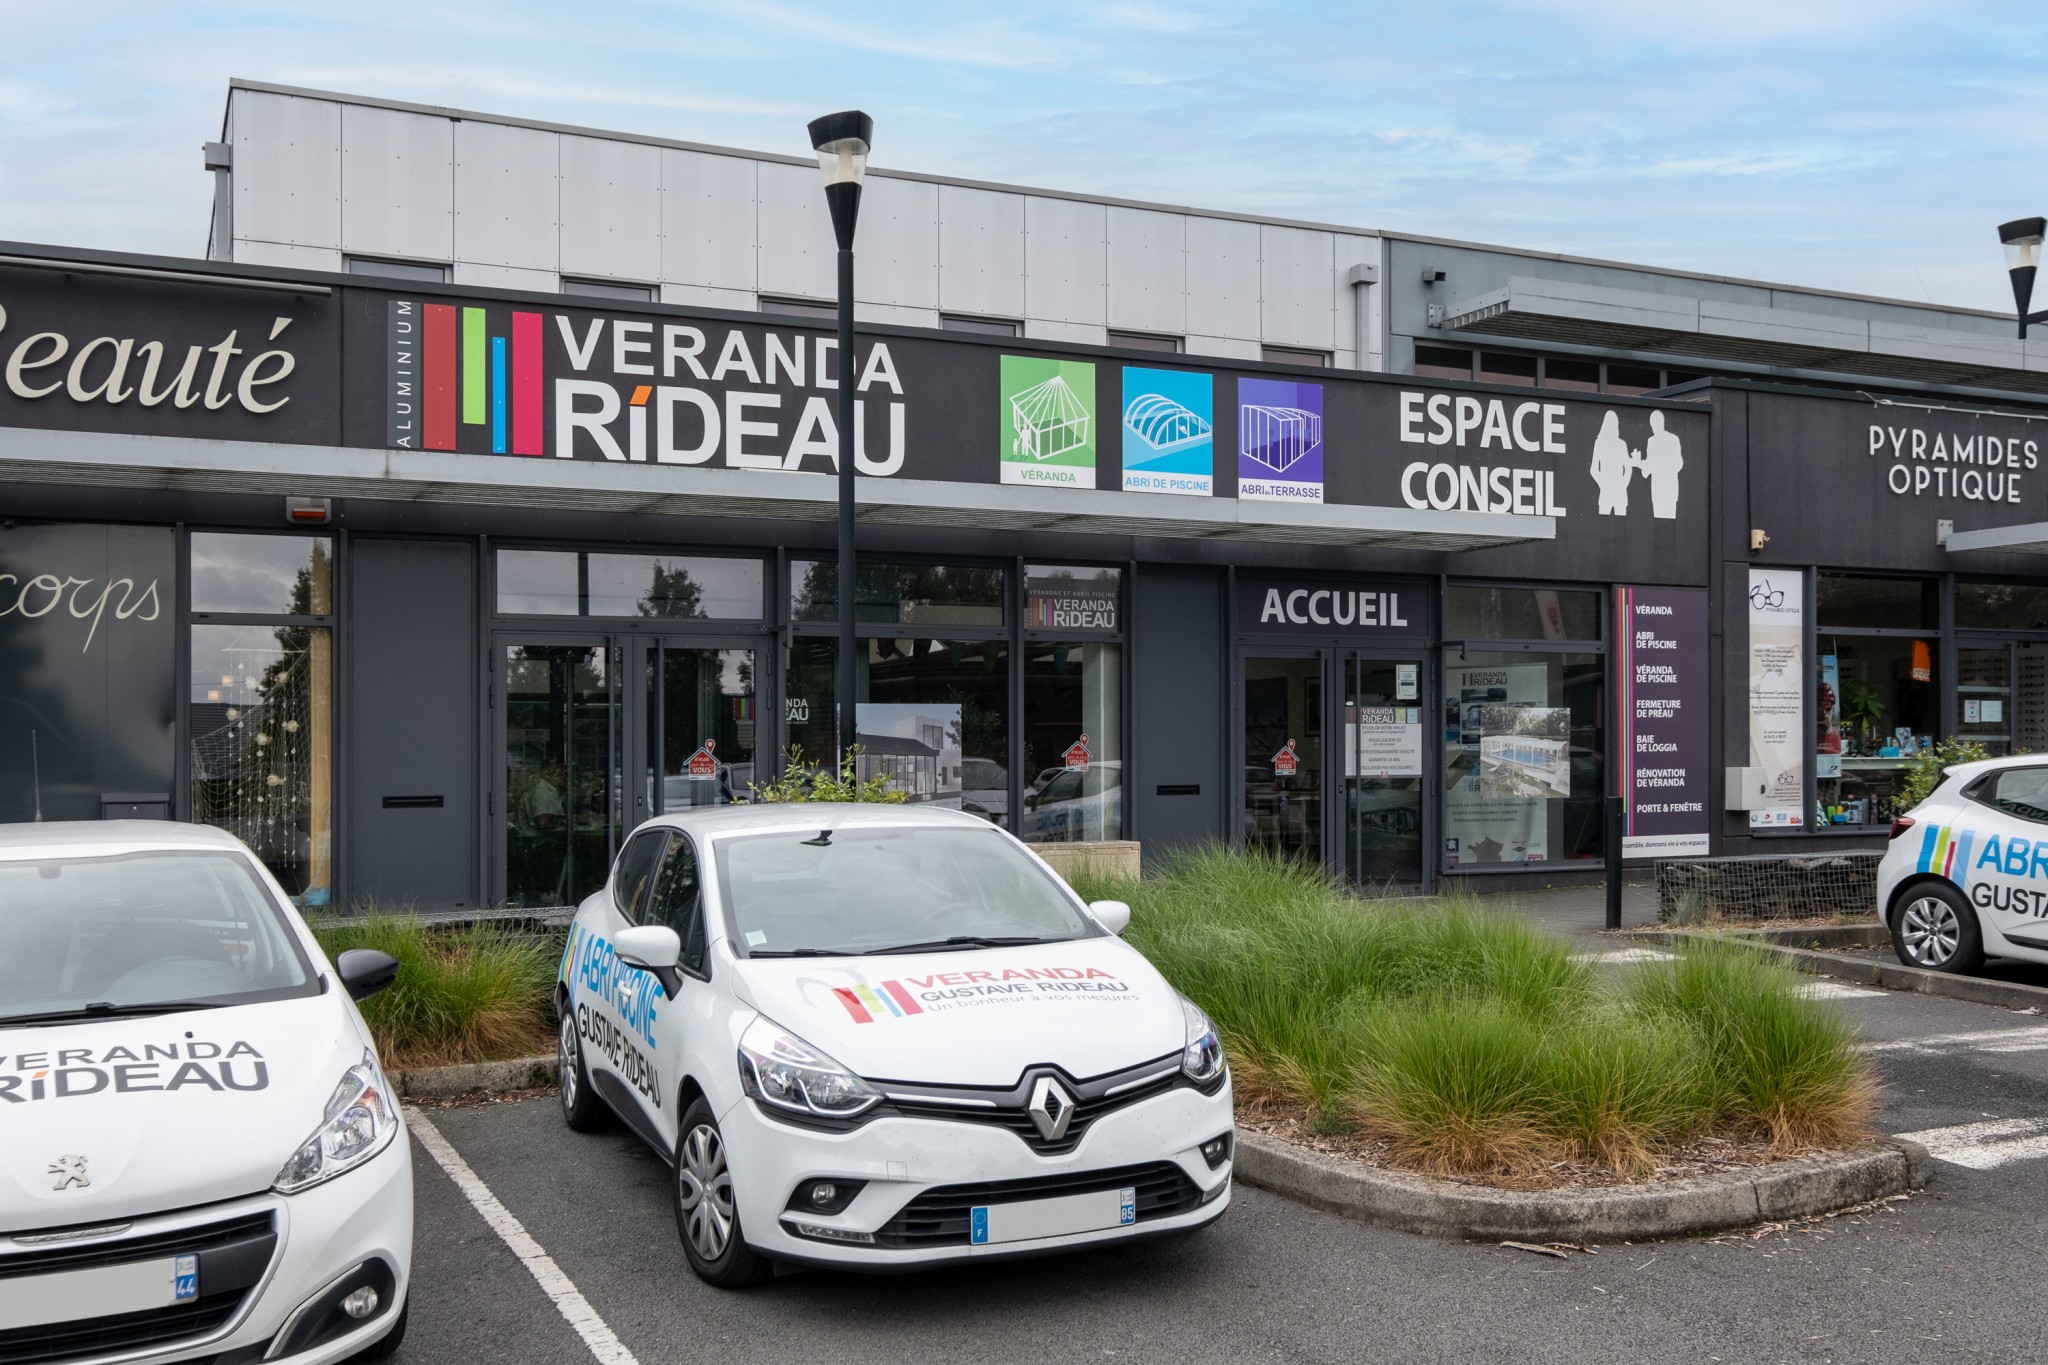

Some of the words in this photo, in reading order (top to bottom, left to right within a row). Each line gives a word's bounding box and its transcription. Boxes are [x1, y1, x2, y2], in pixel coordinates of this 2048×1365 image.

[0, 303, 295, 413] eauté
[555, 315, 904, 394] VERANDA
[397, 301, 412, 448] ALUMINIUM
[1400, 391, 1566, 453] ESPACE
[1869, 425, 2038, 469] PYRAMIDES
[1020, 468, 1076, 482] VÉRANDA
[1125, 477, 1150, 487] ABRI
[1153, 478, 1168, 489] DE
[1170, 480, 1210, 491] PISCINE
[1401, 462, 1566, 517] CONSEIL
[1888, 464, 2021, 503] OPTIQUE
[1053, 599, 1115, 611] VERANDA
[1260, 588, 1408, 627] ACCUEIL
[1635, 604, 1672, 615] VÉRANDA
[1636, 632, 1654, 640] ABRI
[1648, 640, 1677, 649] PISCINE
[1636, 664, 1673, 674] VÉRANDA
[1636, 675, 1647, 683] DE
[1648, 675, 1677, 683] PISCINE
[1636, 700, 1681, 708] FERMETURE
[1636, 709, 1647, 717] DE
[1649, 708, 1673, 718] PRÉAU
[1637, 735, 1654, 743] BAIE
[1637, 744, 1647, 752] DE
[1649, 743, 1677, 752] LOGGIA
[1637, 768, 1685, 778] RÉNOVATION
[1637, 779, 1647, 787] DE
[1648, 777, 1685, 787] VÉRANDA
[1637, 804, 1662, 813] PORTE
[1663, 804, 1669, 812] &
[1670, 801, 1702, 812] FENÊTRE
[580, 934, 615, 1004] ABRI
[906, 967, 1117, 989] VERANDA
[920, 982, 1033, 1003] GUSTAVE
[928, 1002, 954, 1012] Un
[956, 994, 1026, 1008] bonheur
[1031, 993, 1041, 1002] à
[1045, 994, 1073, 1002] vos
[1075, 993, 1140, 1002] mesures
[577, 1002, 619, 1067] GUSTAVE
[1121, 1207, 1134, 1221] 85
[977, 1229, 983, 1238] F
[177, 1277, 196, 1296] 44
